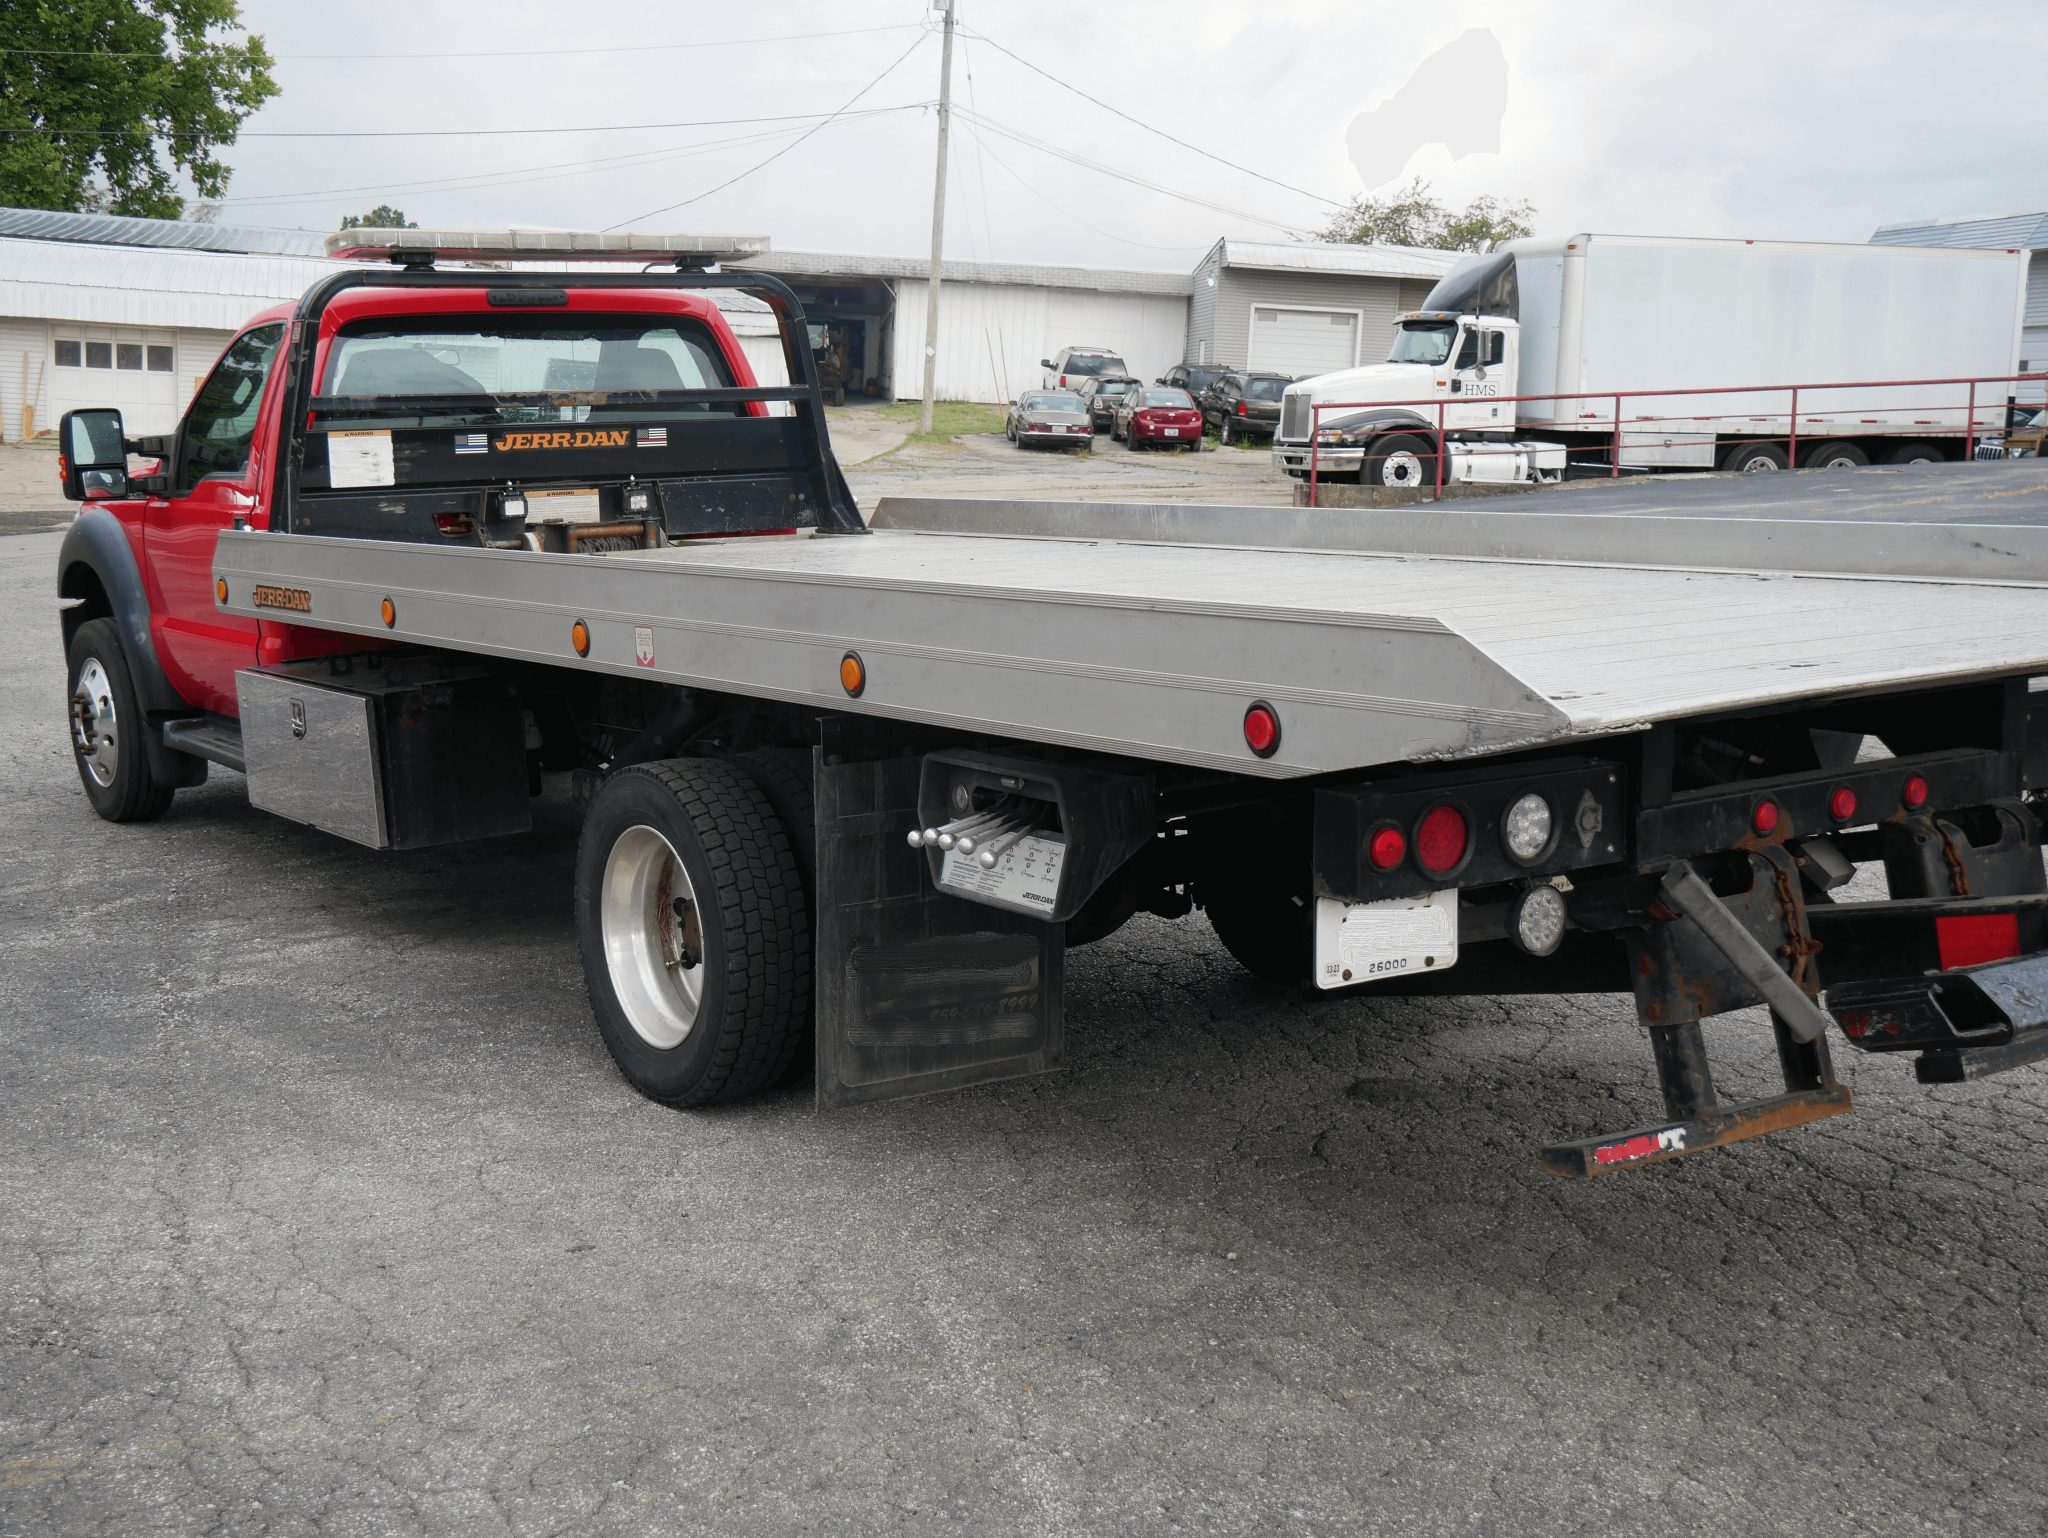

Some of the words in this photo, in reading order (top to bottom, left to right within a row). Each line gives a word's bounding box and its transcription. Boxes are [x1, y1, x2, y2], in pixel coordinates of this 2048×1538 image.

[1465, 383, 1496, 397] HMS
[495, 430, 629, 451] JERR-DAN
[253, 586, 311, 612] JERR-DAN
[1022, 891, 1055, 905] JERR-DAN
[1369, 958, 1407, 973] 26000
